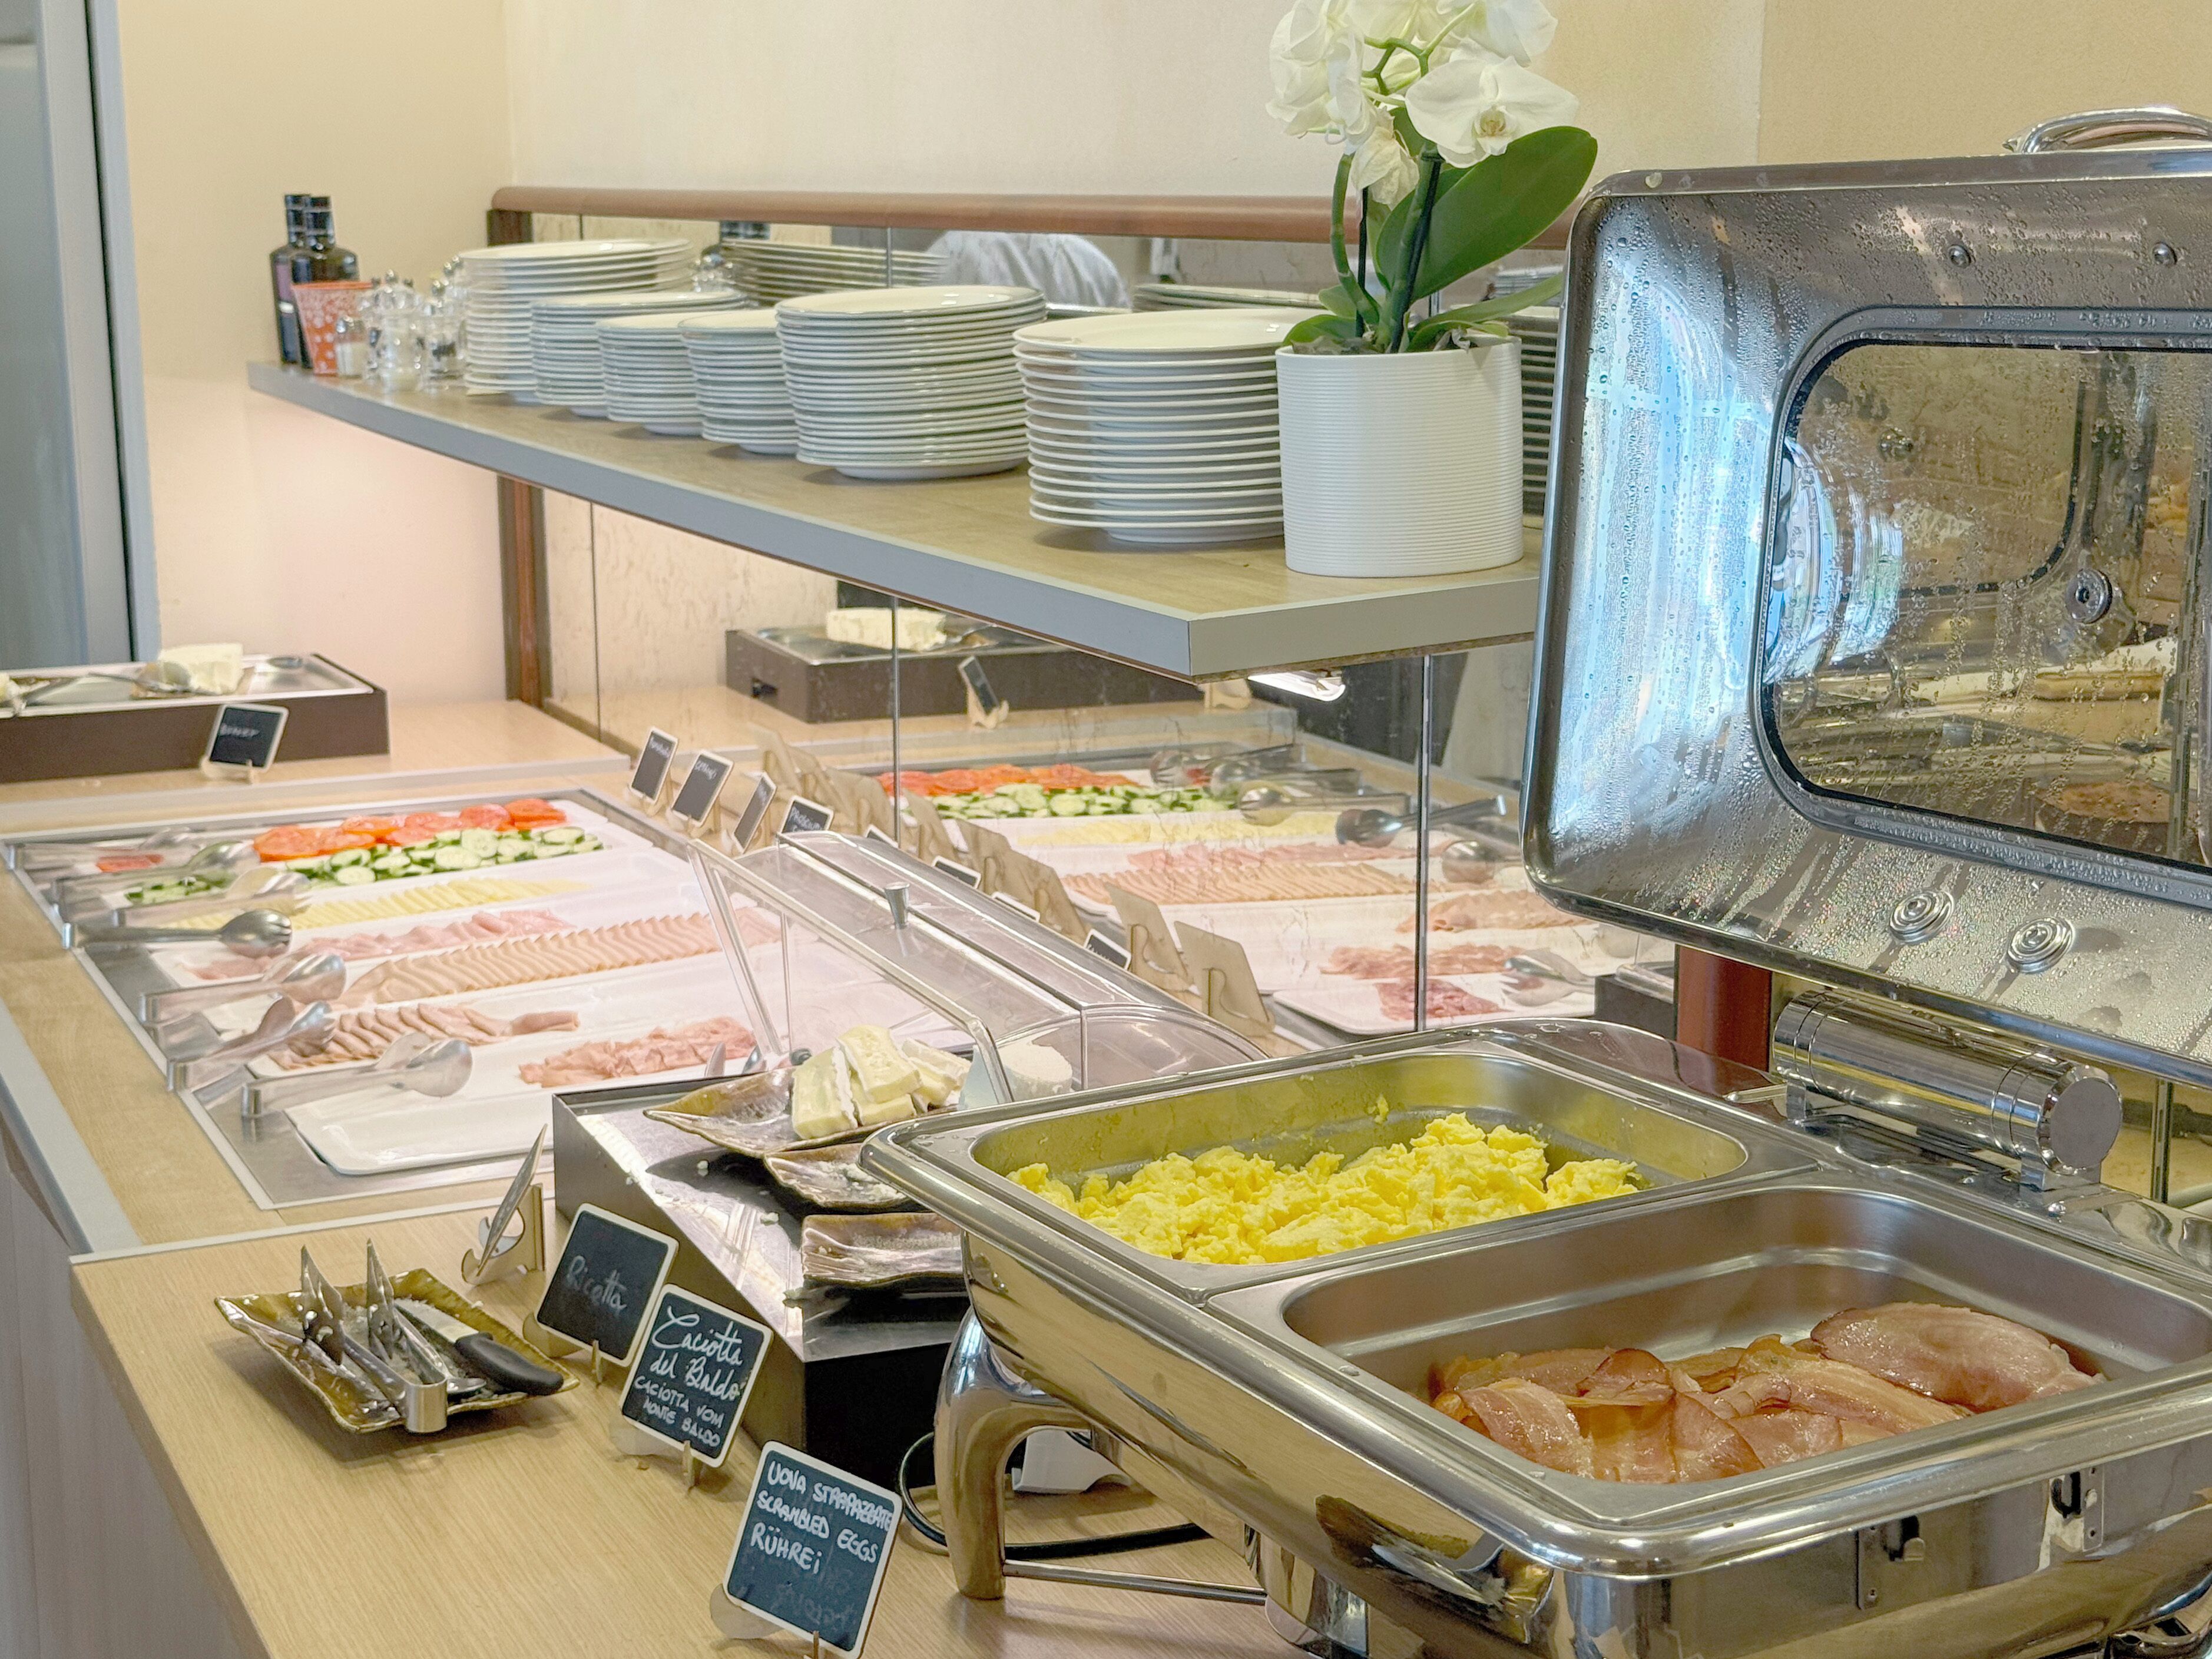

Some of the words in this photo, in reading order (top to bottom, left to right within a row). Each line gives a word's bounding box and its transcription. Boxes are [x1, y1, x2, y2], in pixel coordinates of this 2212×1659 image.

[566, 1254, 628, 1310] Ricotta
[651, 1305, 743, 1366] Caciotta
[650, 1350, 678, 1379] del
[685, 1356, 741, 1401] Baldo
[643, 1398, 677, 1425] MONTE
[681, 1417, 721, 1447] BALDO
[697, 1405, 724, 1428] VOM
[767, 1460, 807, 1495] UOVA
[756, 1490, 830, 1539] SCRAMBLED
[837, 1528, 879, 1563] EGGS
